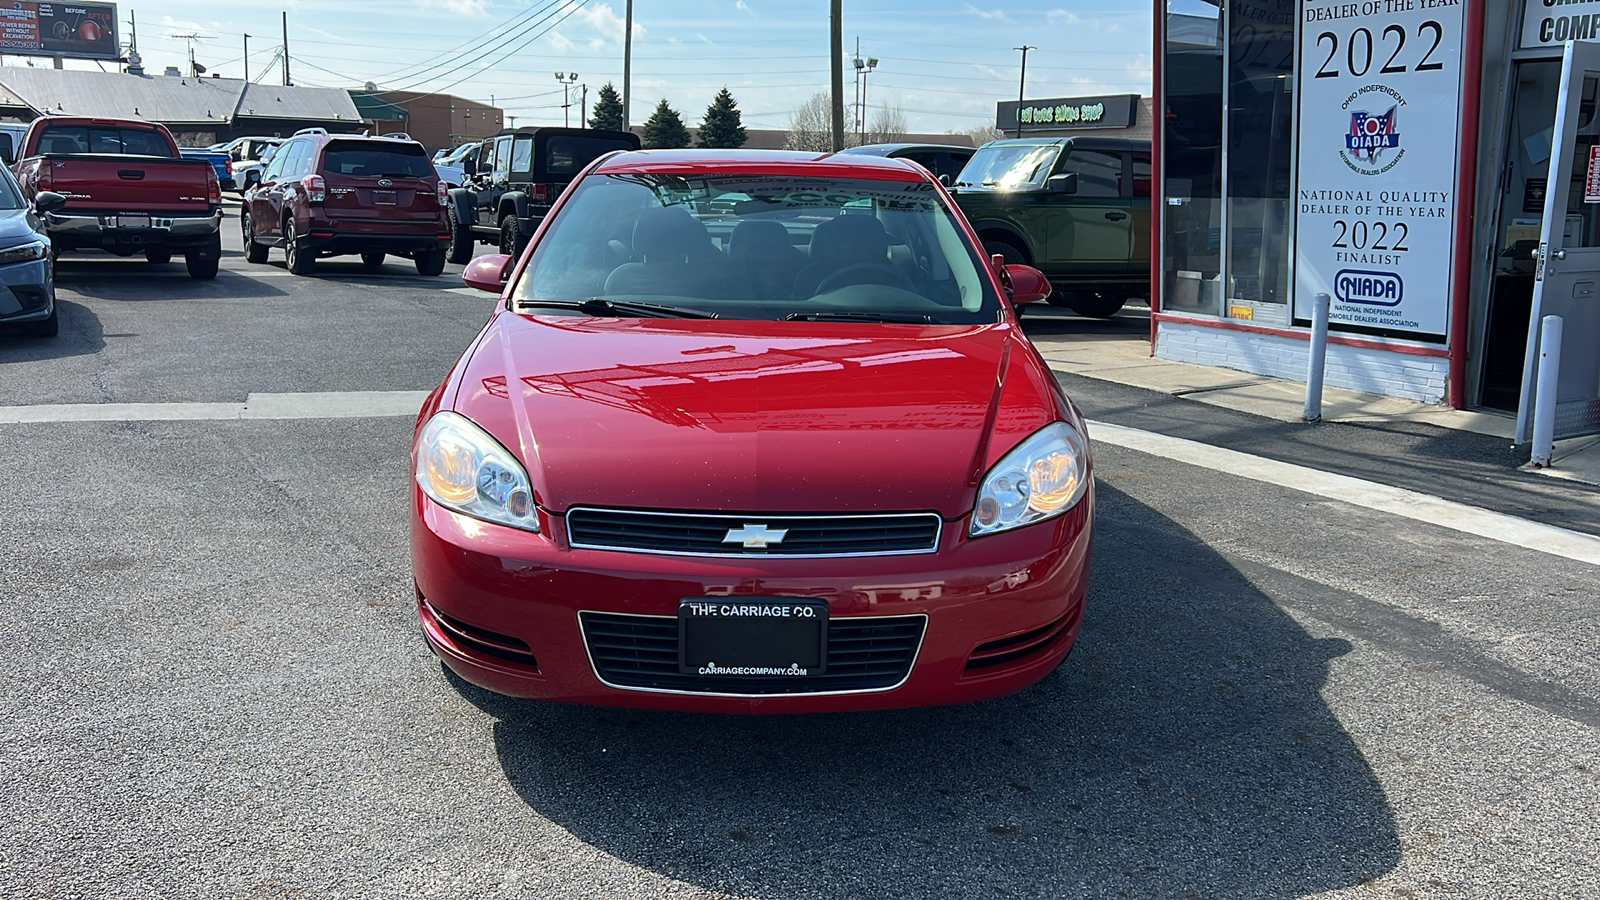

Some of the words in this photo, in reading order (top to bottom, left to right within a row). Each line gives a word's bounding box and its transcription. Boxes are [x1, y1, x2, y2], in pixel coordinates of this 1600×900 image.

[1306, 4, 1359, 22] DEALER
[1362, 1, 1381, 16] OF
[1384, 0, 1414, 13] THE
[1314, 20, 1443, 79] 2022
[1341, 92, 1358, 110] OHIO
[1358, 84, 1407, 107] INDEPENDENT
[1081, 103, 1103, 121] SHOP
[1351, 135, 1390, 148] OIADA
[1339, 150, 1360, 173] AUTOMOBILE
[1381, 148, 1406, 174] ASSOCIATION
[1300, 190, 1373, 201] NATIONAL
[1379, 191, 1449, 203] QUALITY
[1301, 204, 1349, 215] DEALER
[1355, 205, 1371, 215] OF
[1377, 206, 1403, 216] THE
[1410, 207, 1446, 218] YEAR
[1332, 220, 1409, 252] 2022
[1336, 252, 1401, 266] FINALIST
[1340, 276, 1397, 300] NIADA
[1334, 305, 1361, 313] NATIONAL
[1363, 307, 1402, 317] INDEPENDENT
[1328, 313, 1353, 321] OMOBILE
[1354, 315, 1378, 324] DEALERS
[1379, 318, 1419, 328] ASSOCIATION
[690, 604, 718, 616] THE
[720, 605, 790, 617] CARRIAGE
[793, 606, 816, 618] CO.
[698, 666, 807, 676] CARRIAGECOMPANY.COM
